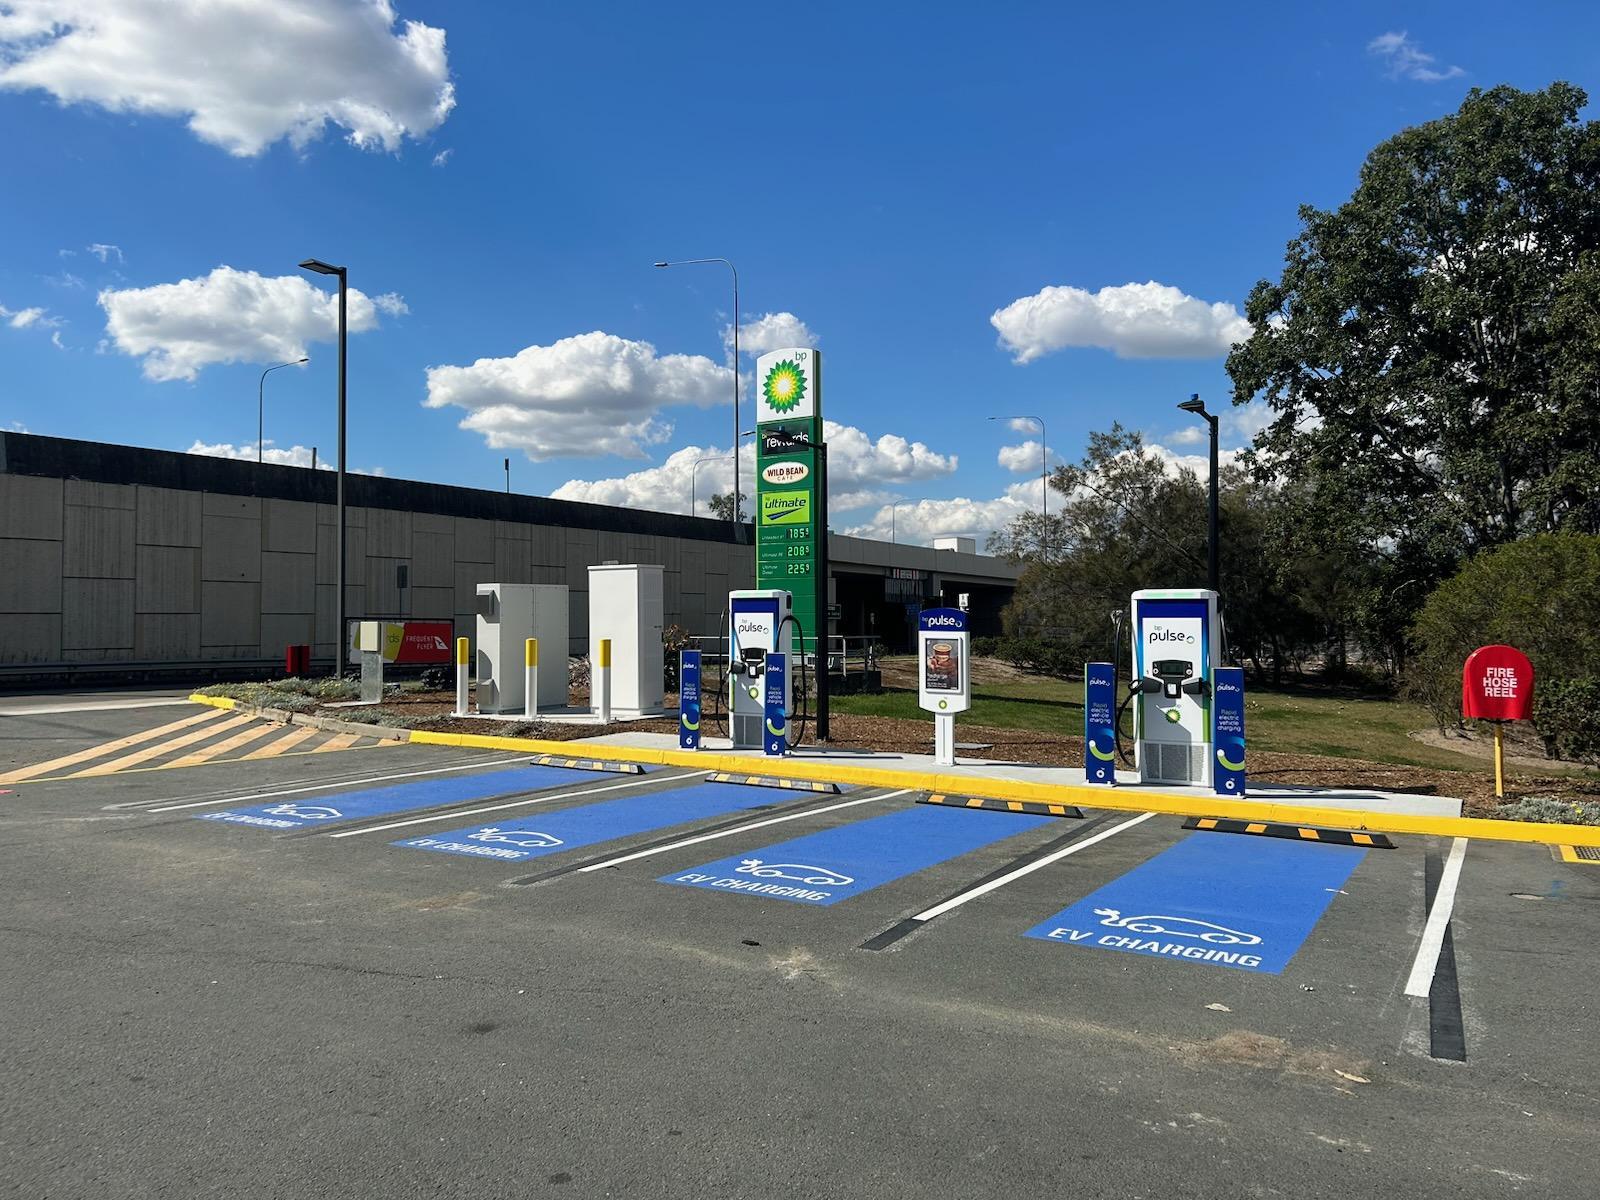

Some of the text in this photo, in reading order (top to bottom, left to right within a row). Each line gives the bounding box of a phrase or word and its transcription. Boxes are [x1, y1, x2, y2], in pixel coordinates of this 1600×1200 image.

[795, 352, 807, 362] bp
[767, 466, 804, 478] WILD BEAN
[765, 498, 806, 508] ultimate
[928, 615, 956, 627] pulse
[738, 622, 763, 634] pulse
[1150, 630, 1185, 644] pulse
[1486, 668, 1514, 678] FIRE
[1090, 678, 1106, 686] pulse
[1482, 677, 1518, 688] HOSE
[1484, 687, 1516, 698] REEL
[434, 843, 529, 858] CHARGING
[676, 873, 831, 901] EV CHARGING
[1048, 927, 1262, 967] EV CHARGING
